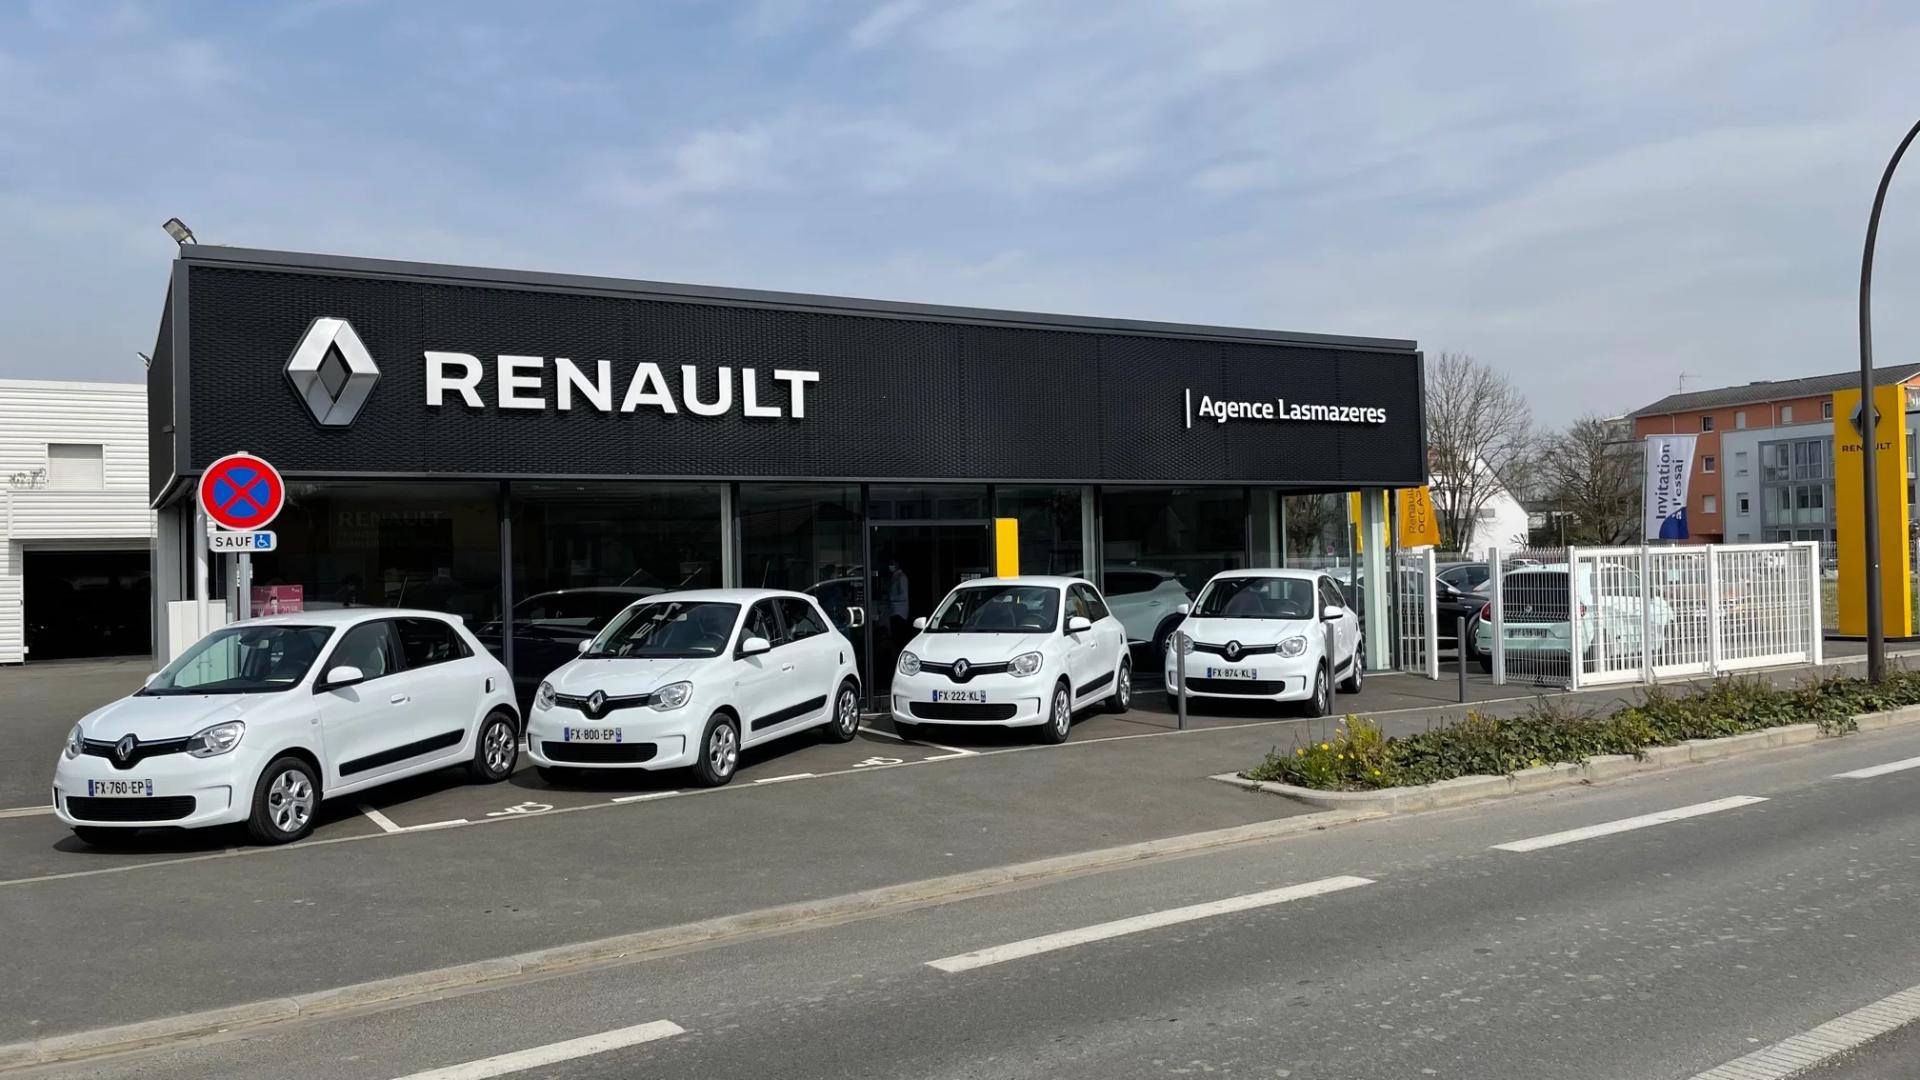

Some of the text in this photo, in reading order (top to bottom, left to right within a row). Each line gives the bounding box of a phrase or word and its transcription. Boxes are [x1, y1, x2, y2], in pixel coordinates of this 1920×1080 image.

[424, 351, 820, 418] RENAULT
[1199, 396, 1387, 423] Agence Lasmazeres
[1841, 442, 1892, 452] RENULT
[1655, 443, 1670, 519] Invitation
[1672, 459, 1684, 506] l'essai
[215, 536, 253, 547] SAUF
[1212, 668, 1251, 678] FX-874-KL
[938, 691, 979, 701] FX-222-KL
[571, 729, 614, 740] FX-800-EP
[95, 781, 144, 794] FX-760-EP
